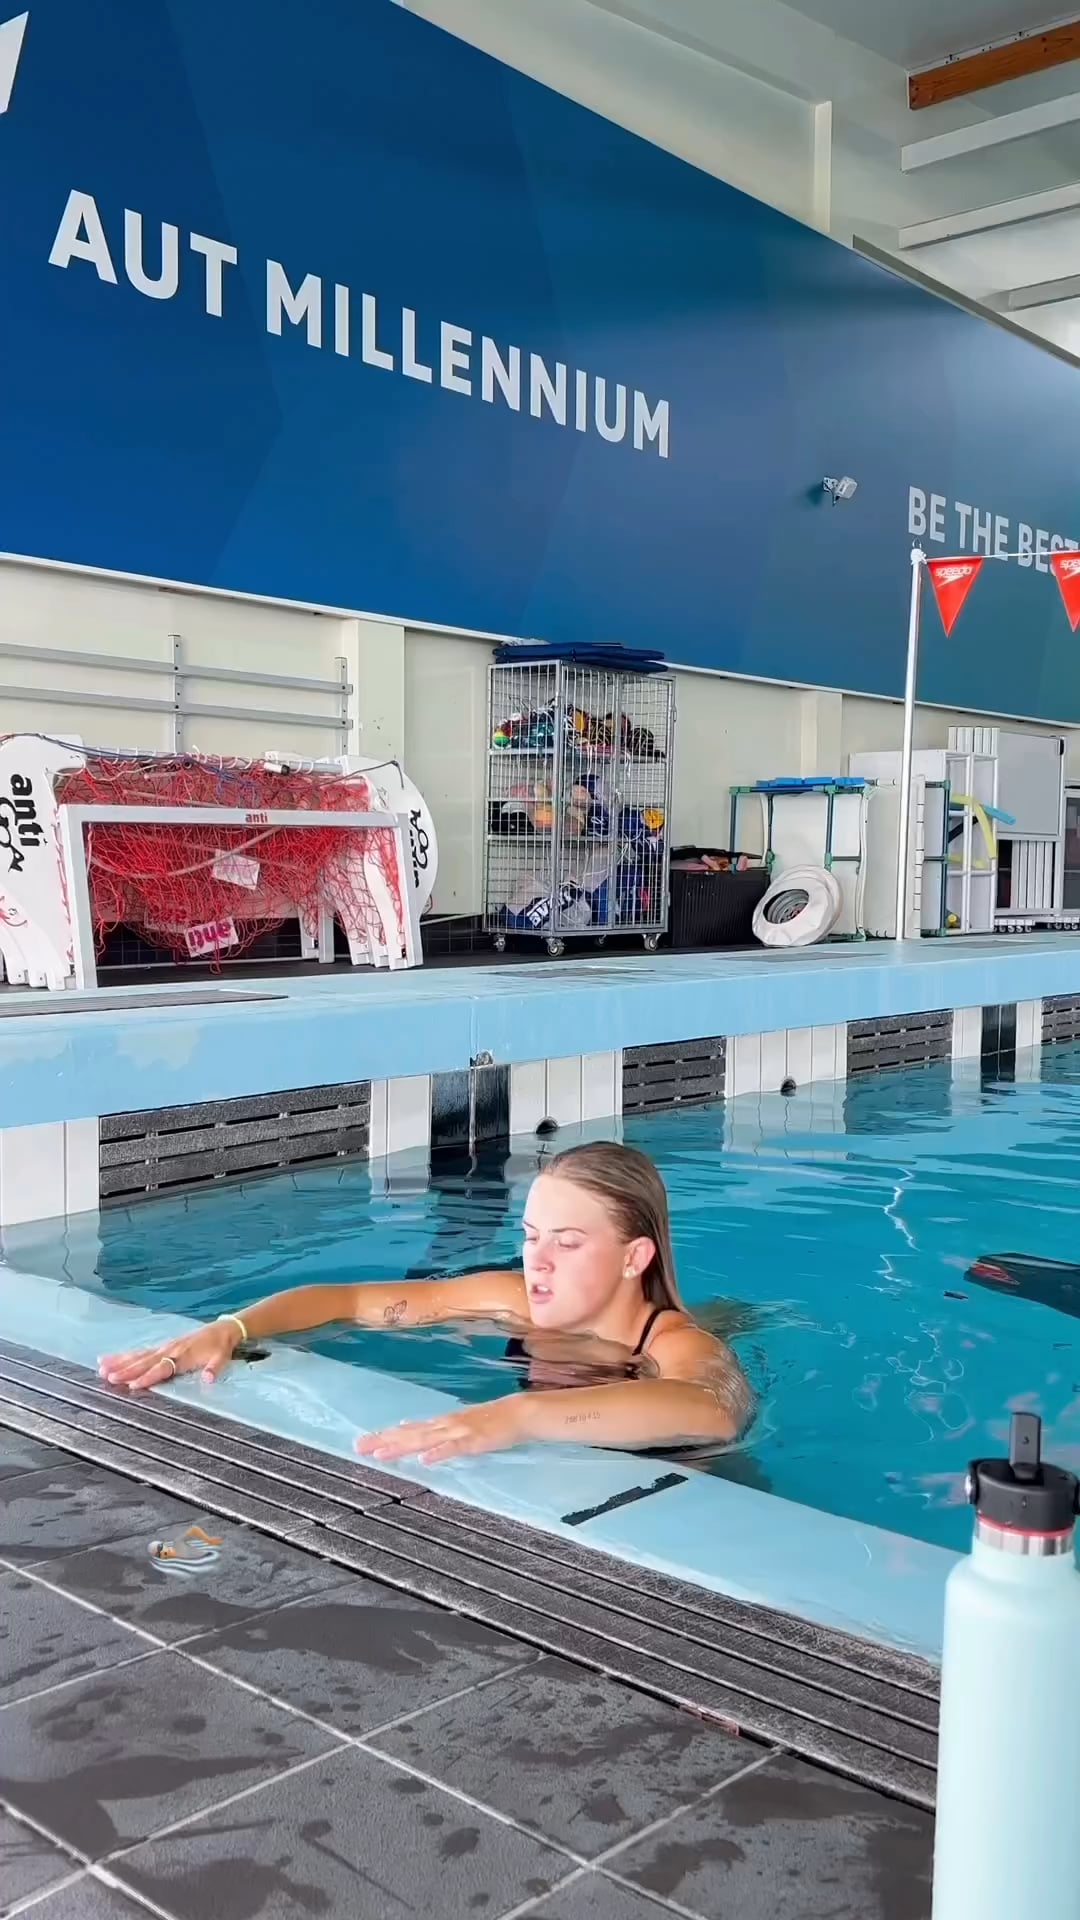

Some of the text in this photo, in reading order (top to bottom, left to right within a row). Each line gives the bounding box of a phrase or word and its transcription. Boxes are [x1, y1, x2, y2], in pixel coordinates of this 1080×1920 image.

[48, 189, 670, 459] AUT MILLENNIUM
[908, 486, 947, 543] BE
[955, 501, 1009, 561] THE
[935, 564, 973, 578] speedo
[10, 773, 48, 847] anti
[244, 811, 268, 825] anti
